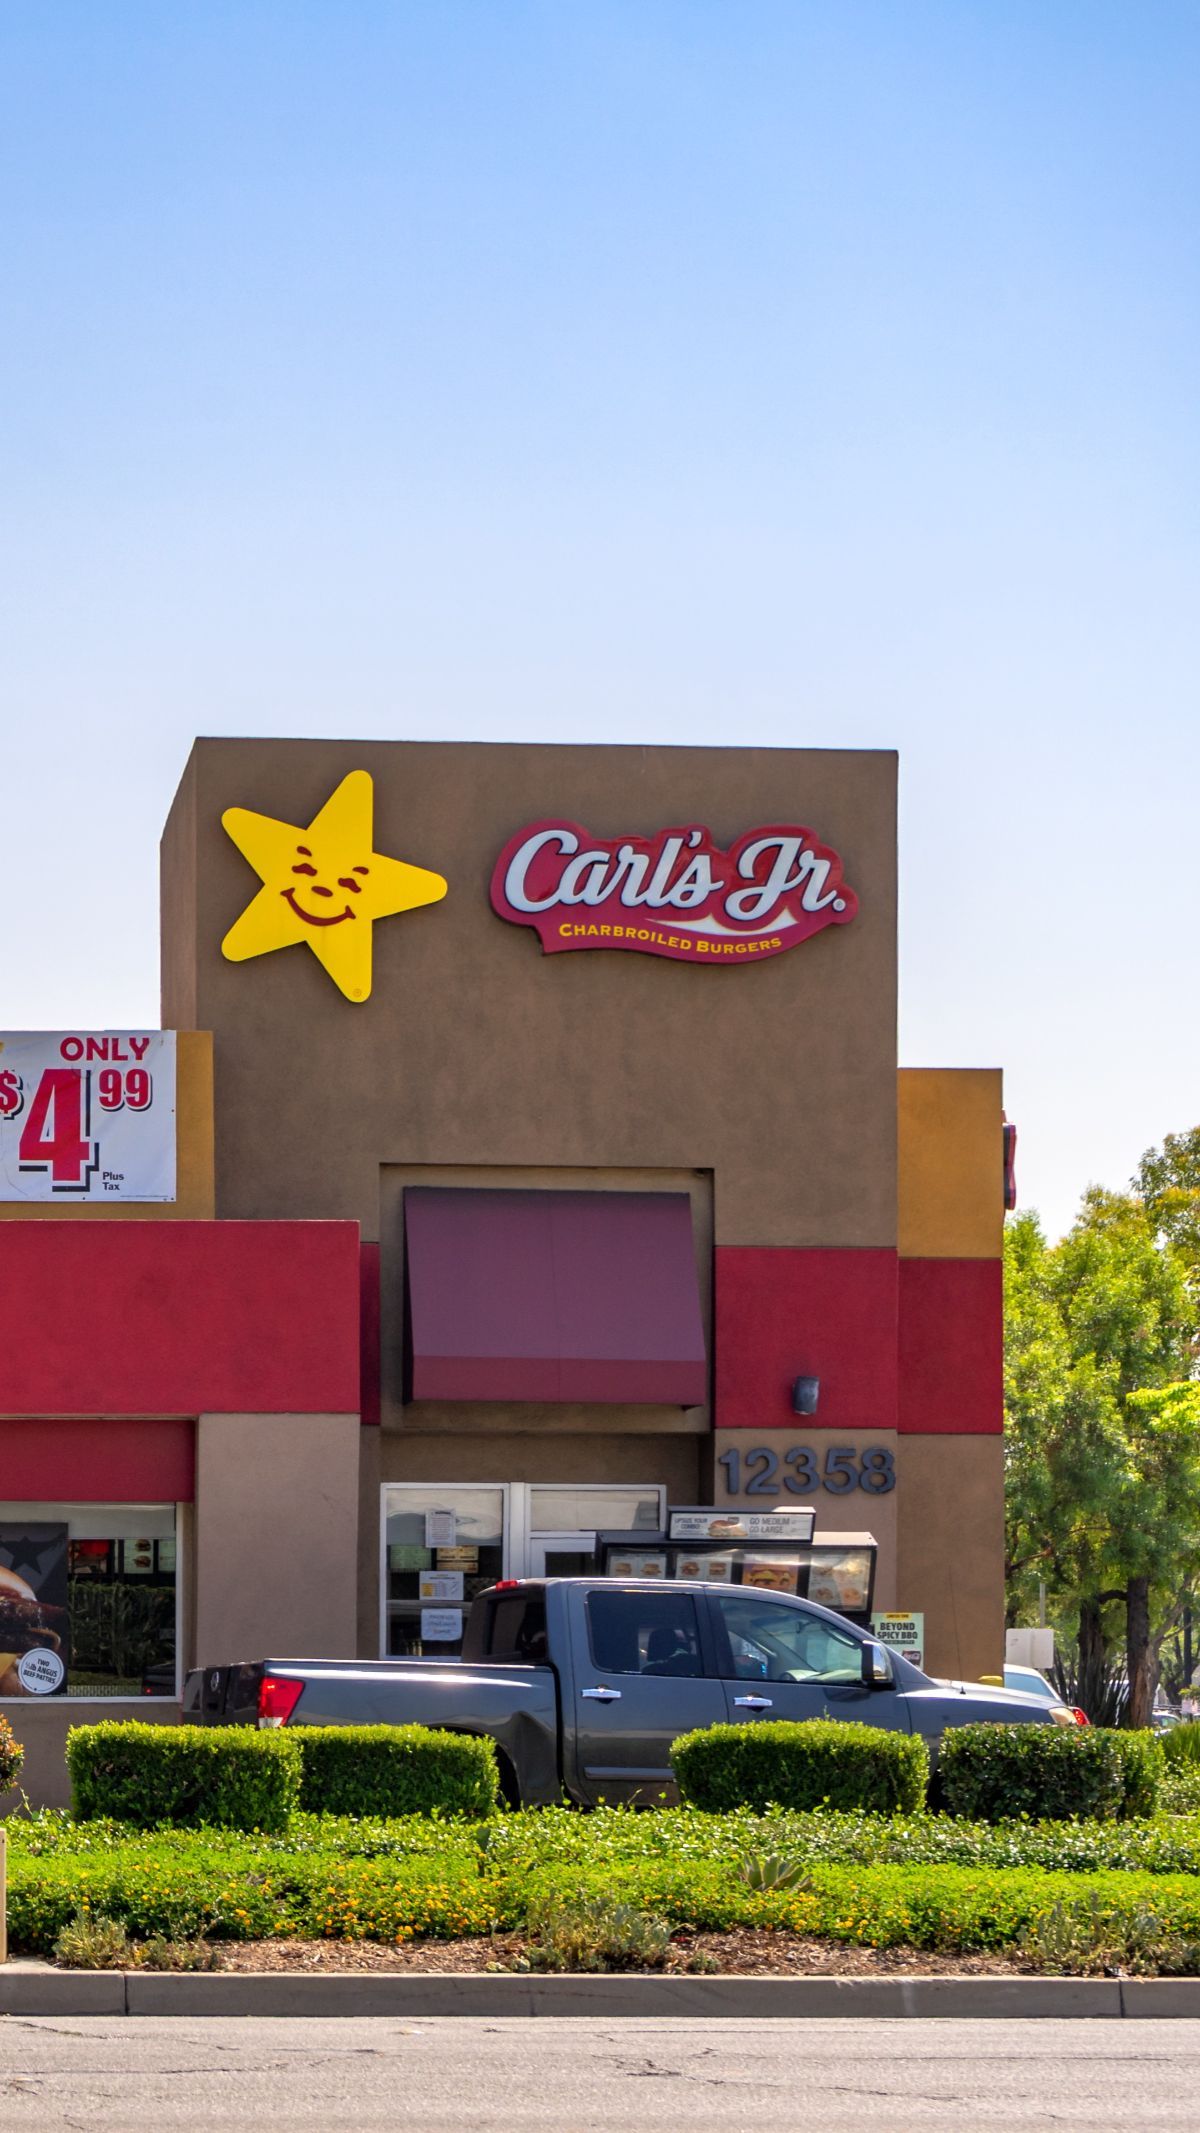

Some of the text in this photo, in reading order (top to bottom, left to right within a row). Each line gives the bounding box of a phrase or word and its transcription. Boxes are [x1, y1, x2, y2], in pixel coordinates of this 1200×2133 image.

[504, 829, 846, 921] Carl's Jr.
[559, 923, 782, 954] CHARBROILED BURGERS
[59, 1037, 150, 1061] ONLY
[102, 1171, 125, 1181] Plus
[102, 1181, 120, 1191] Tax
[719, 1446, 897, 1496] 12358
[749, 1517, 760, 1525] GO
[761, 1517, 790, 1525] MEDIUM
[880, 1622, 915, 1630] BEYOND
[877, 1631, 918, 1639] SPICY BBQ
[37, 1658, 50, 1667] TWO
[37, 1666, 57, 1678] ANGUS
